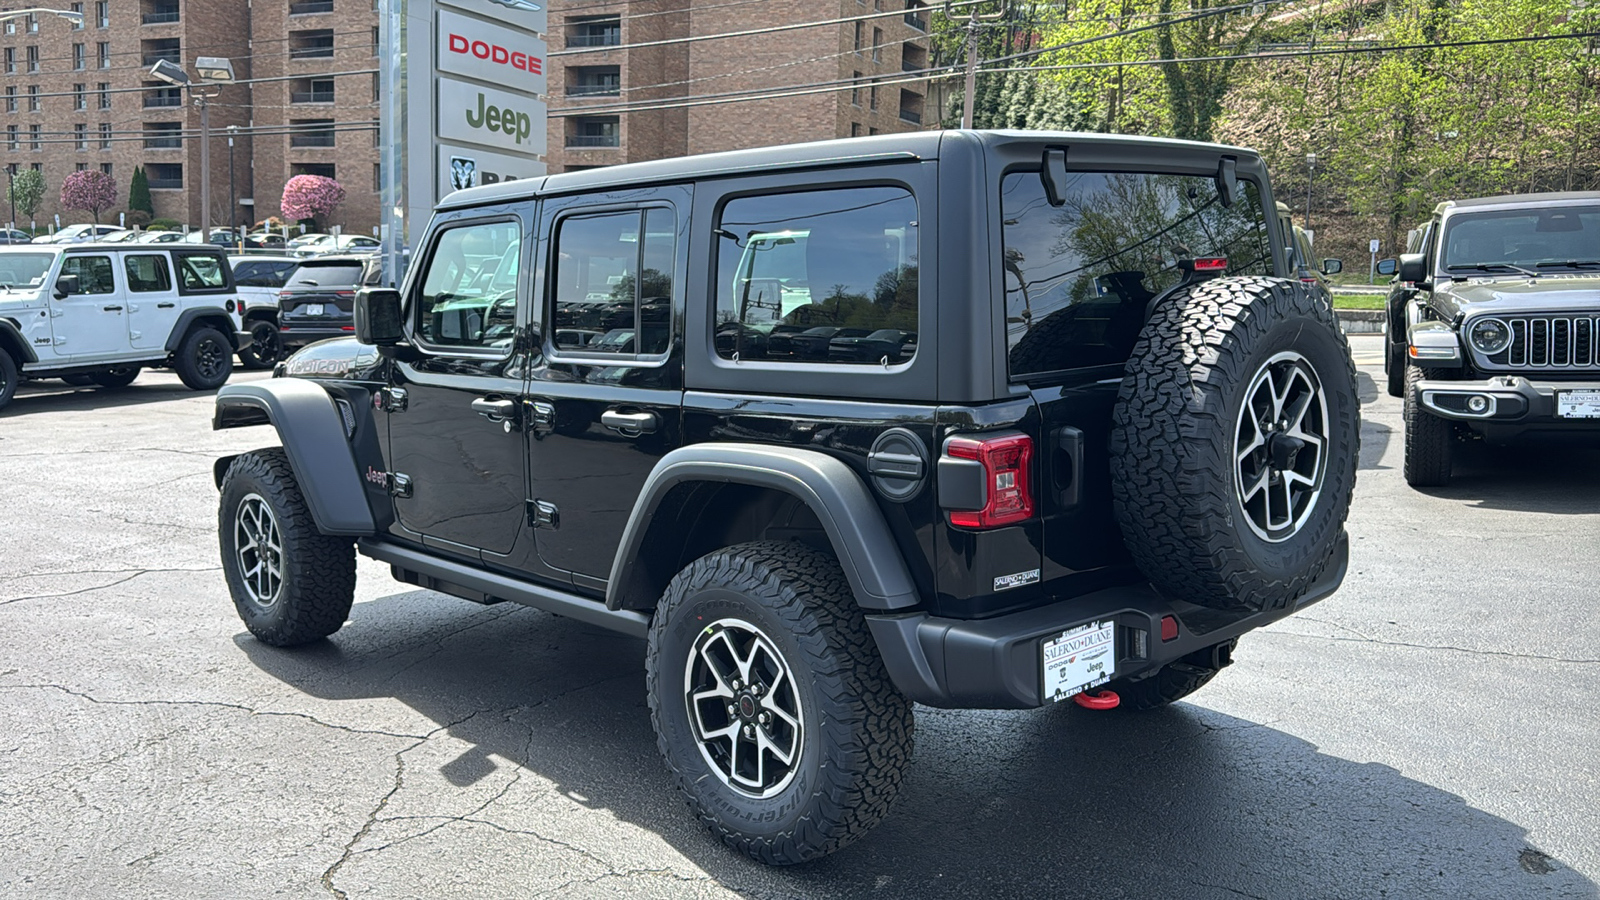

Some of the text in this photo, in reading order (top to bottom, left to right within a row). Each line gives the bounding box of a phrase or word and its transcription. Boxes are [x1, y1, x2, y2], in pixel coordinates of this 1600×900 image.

[449, 33, 542, 75] DODGE
[466, 92, 530, 144] Jeep
[366, 465, 388, 488] Jeep
[1045, 629, 1112, 660] SALERNO DUANE
[1087, 661, 1104, 673] Jeep
[1053, 675, 1111, 702] SALERNO DUANE
